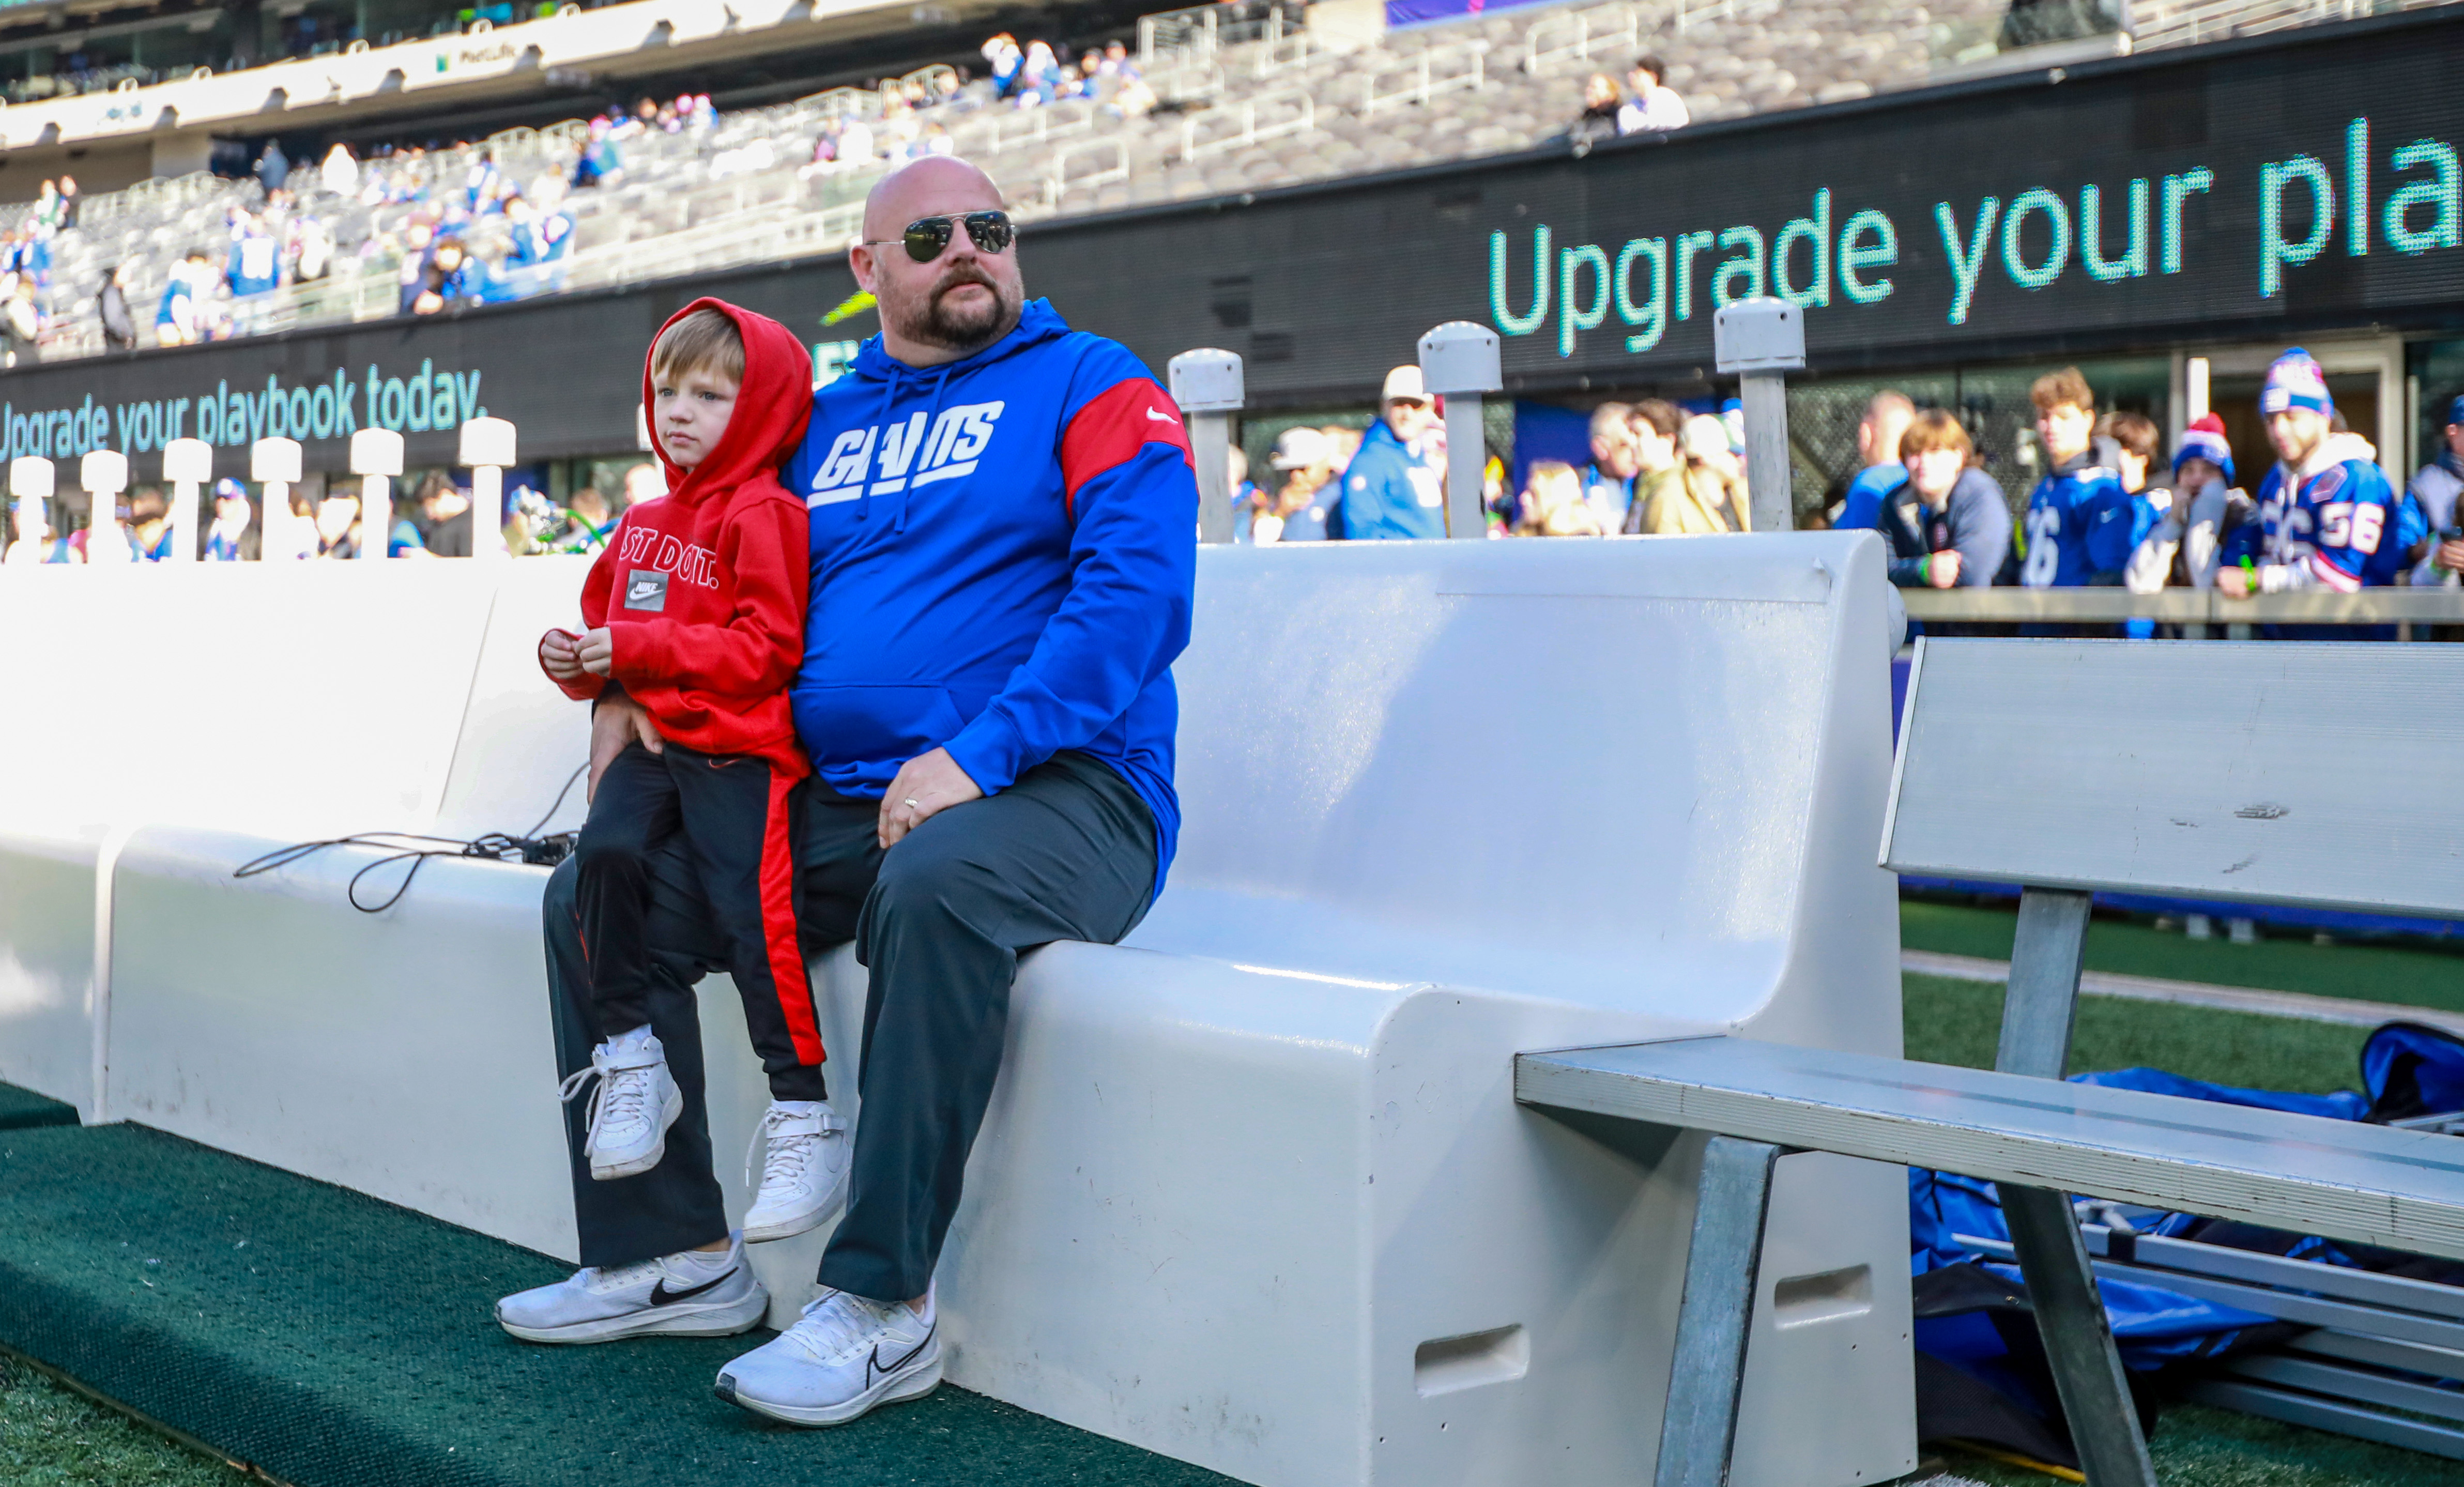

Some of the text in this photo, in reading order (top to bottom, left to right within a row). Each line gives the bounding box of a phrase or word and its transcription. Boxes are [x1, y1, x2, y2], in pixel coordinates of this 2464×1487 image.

[1489, 116, 2463, 357] Upgrade your pla
[117, 397, 190, 456] your
[196, 366, 357, 455] playbook
[812, 400, 1005, 490] GIANTS
[619, 526, 659, 563] ST
[2318, 500, 2386, 556] 56
[635, 581, 659, 592] NIKE
